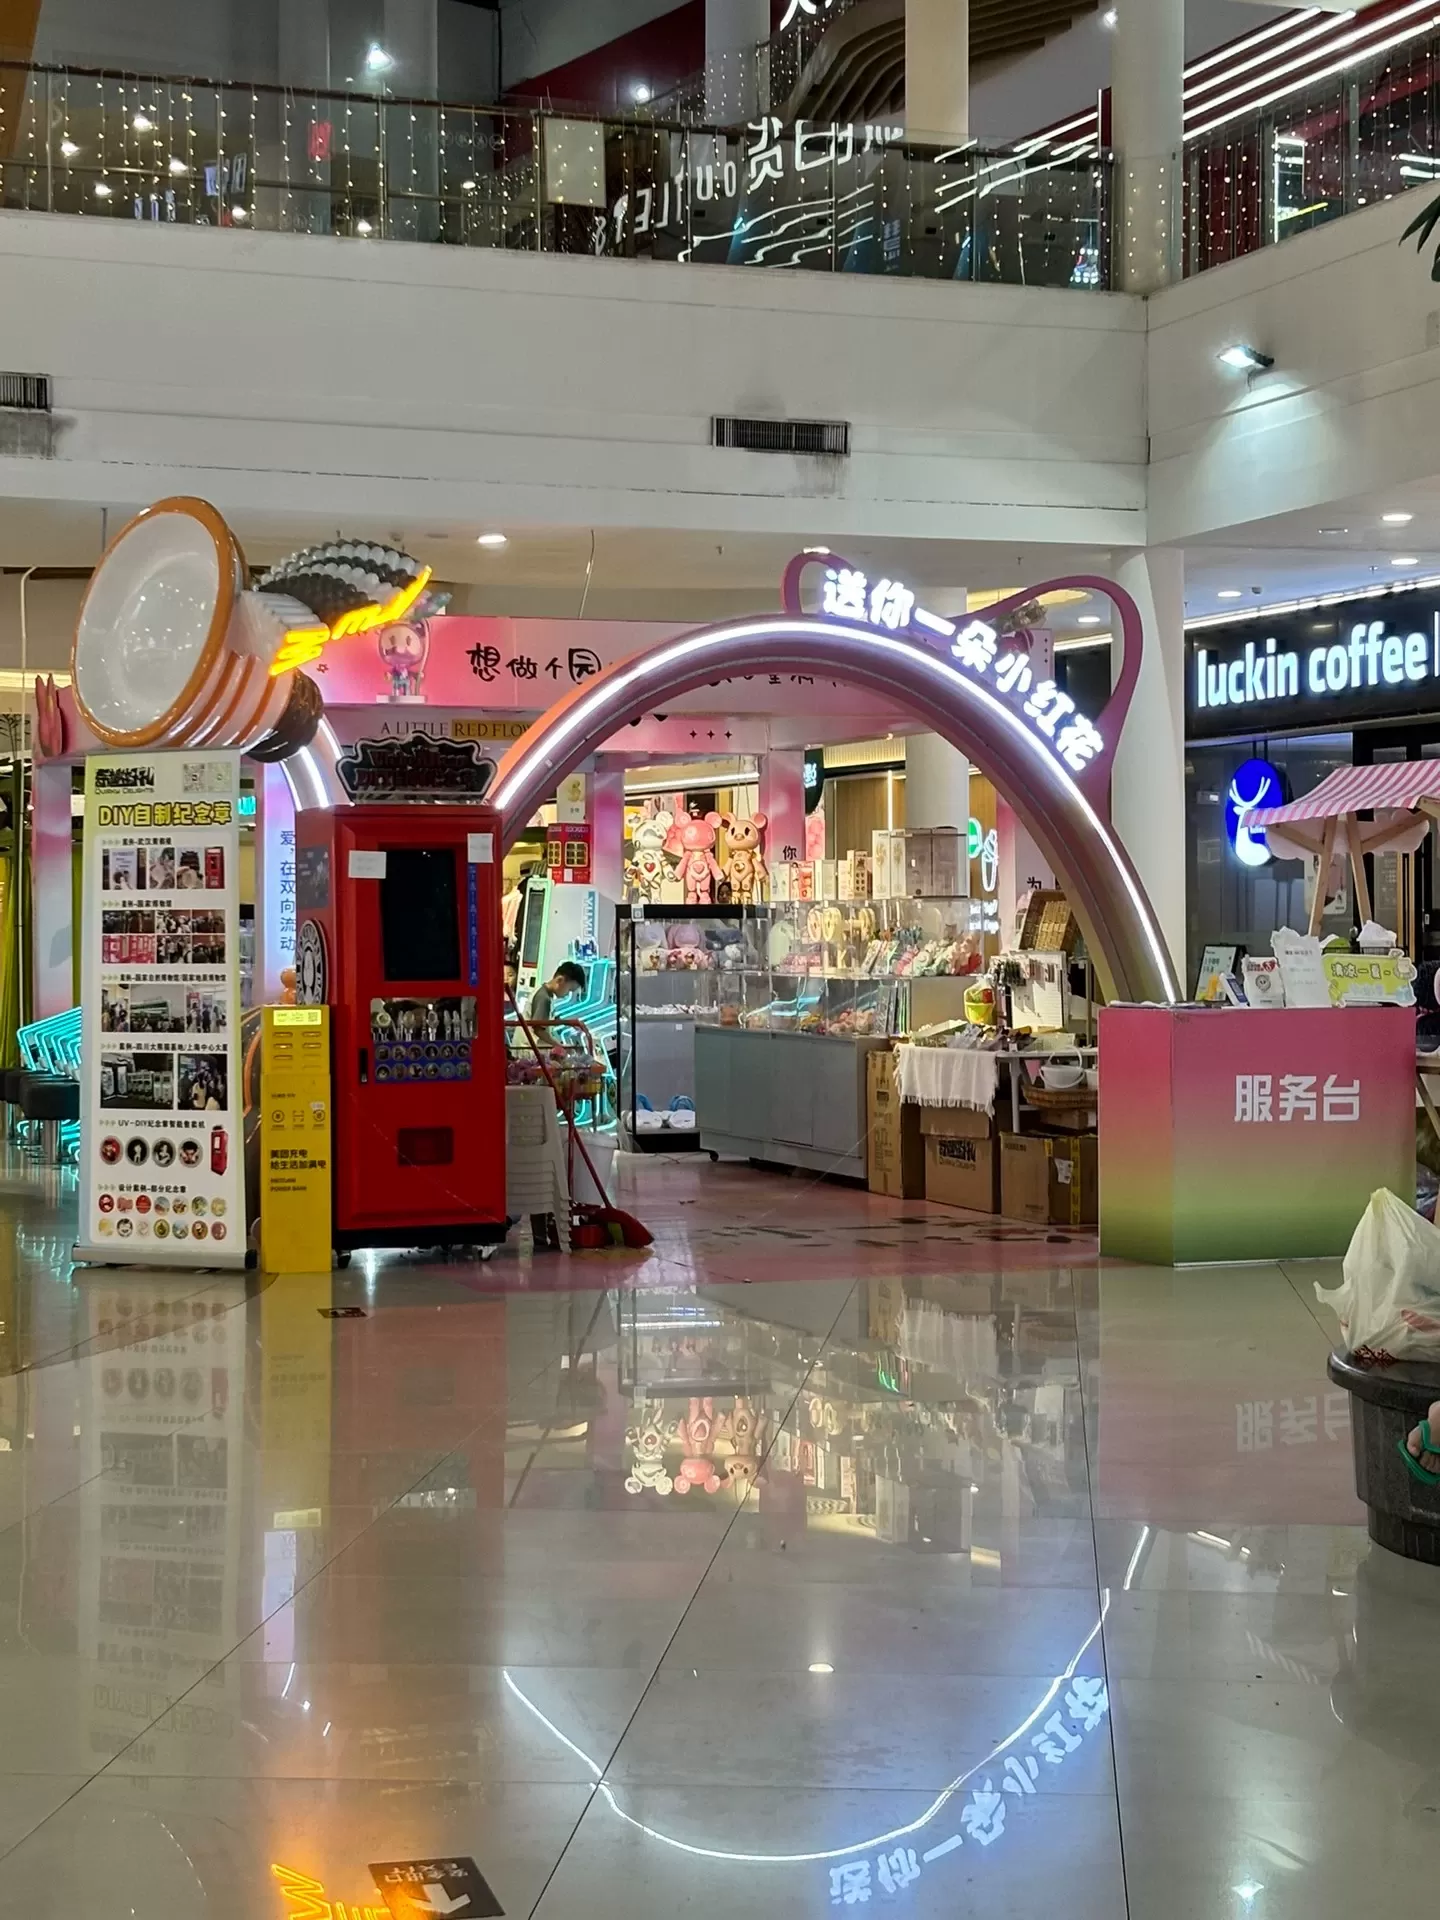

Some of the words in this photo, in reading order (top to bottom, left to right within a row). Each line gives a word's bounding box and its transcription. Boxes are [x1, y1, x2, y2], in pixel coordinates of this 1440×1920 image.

[823, 568, 1105, 771] 送你一朵小红花
[1197, 637, 1298, 707] luckin
[1308, 620, 1428, 693] coffee
[381, 723, 391, 734] A
[396, 722, 448, 736] LITTLE
[454, 723, 488, 737] RED
[99, 801, 232, 827] DIY自制纪念章
[783, 845, 797, 861] 你
[1234, 1074, 1361, 1122] 服务台
